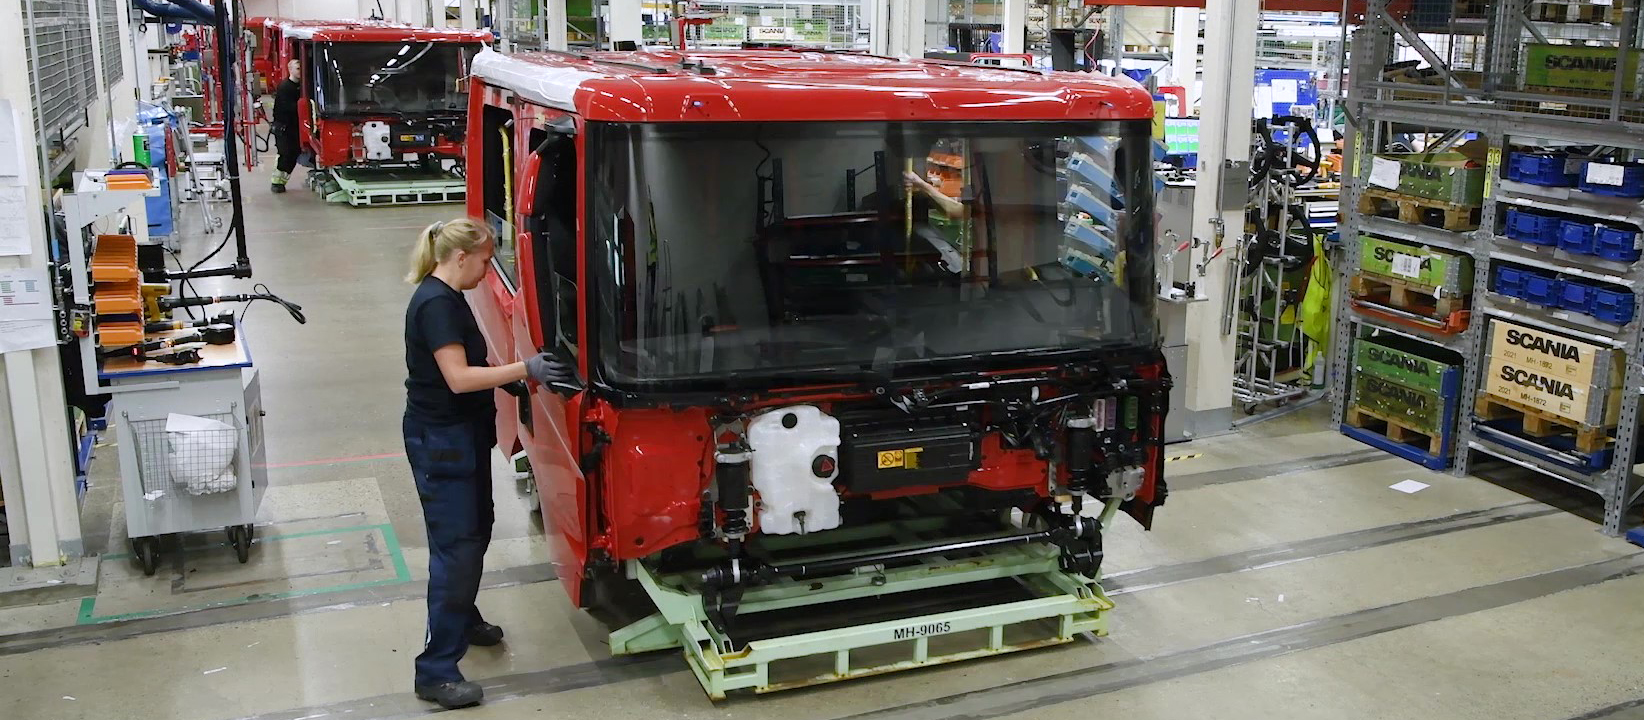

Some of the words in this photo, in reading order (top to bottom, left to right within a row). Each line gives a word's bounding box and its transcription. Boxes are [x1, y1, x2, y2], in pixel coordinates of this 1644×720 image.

[1374, 246, 1432, 272] SCA
[1505, 330, 1580, 363] SCANIA
[1368, 347, 1430, 377] SCANIA
[1500, 365, 1574, 401] SCANIA
[1520, 392, 1547, 406] MH-1872
[894, 621, 951, 640] MH-9065
